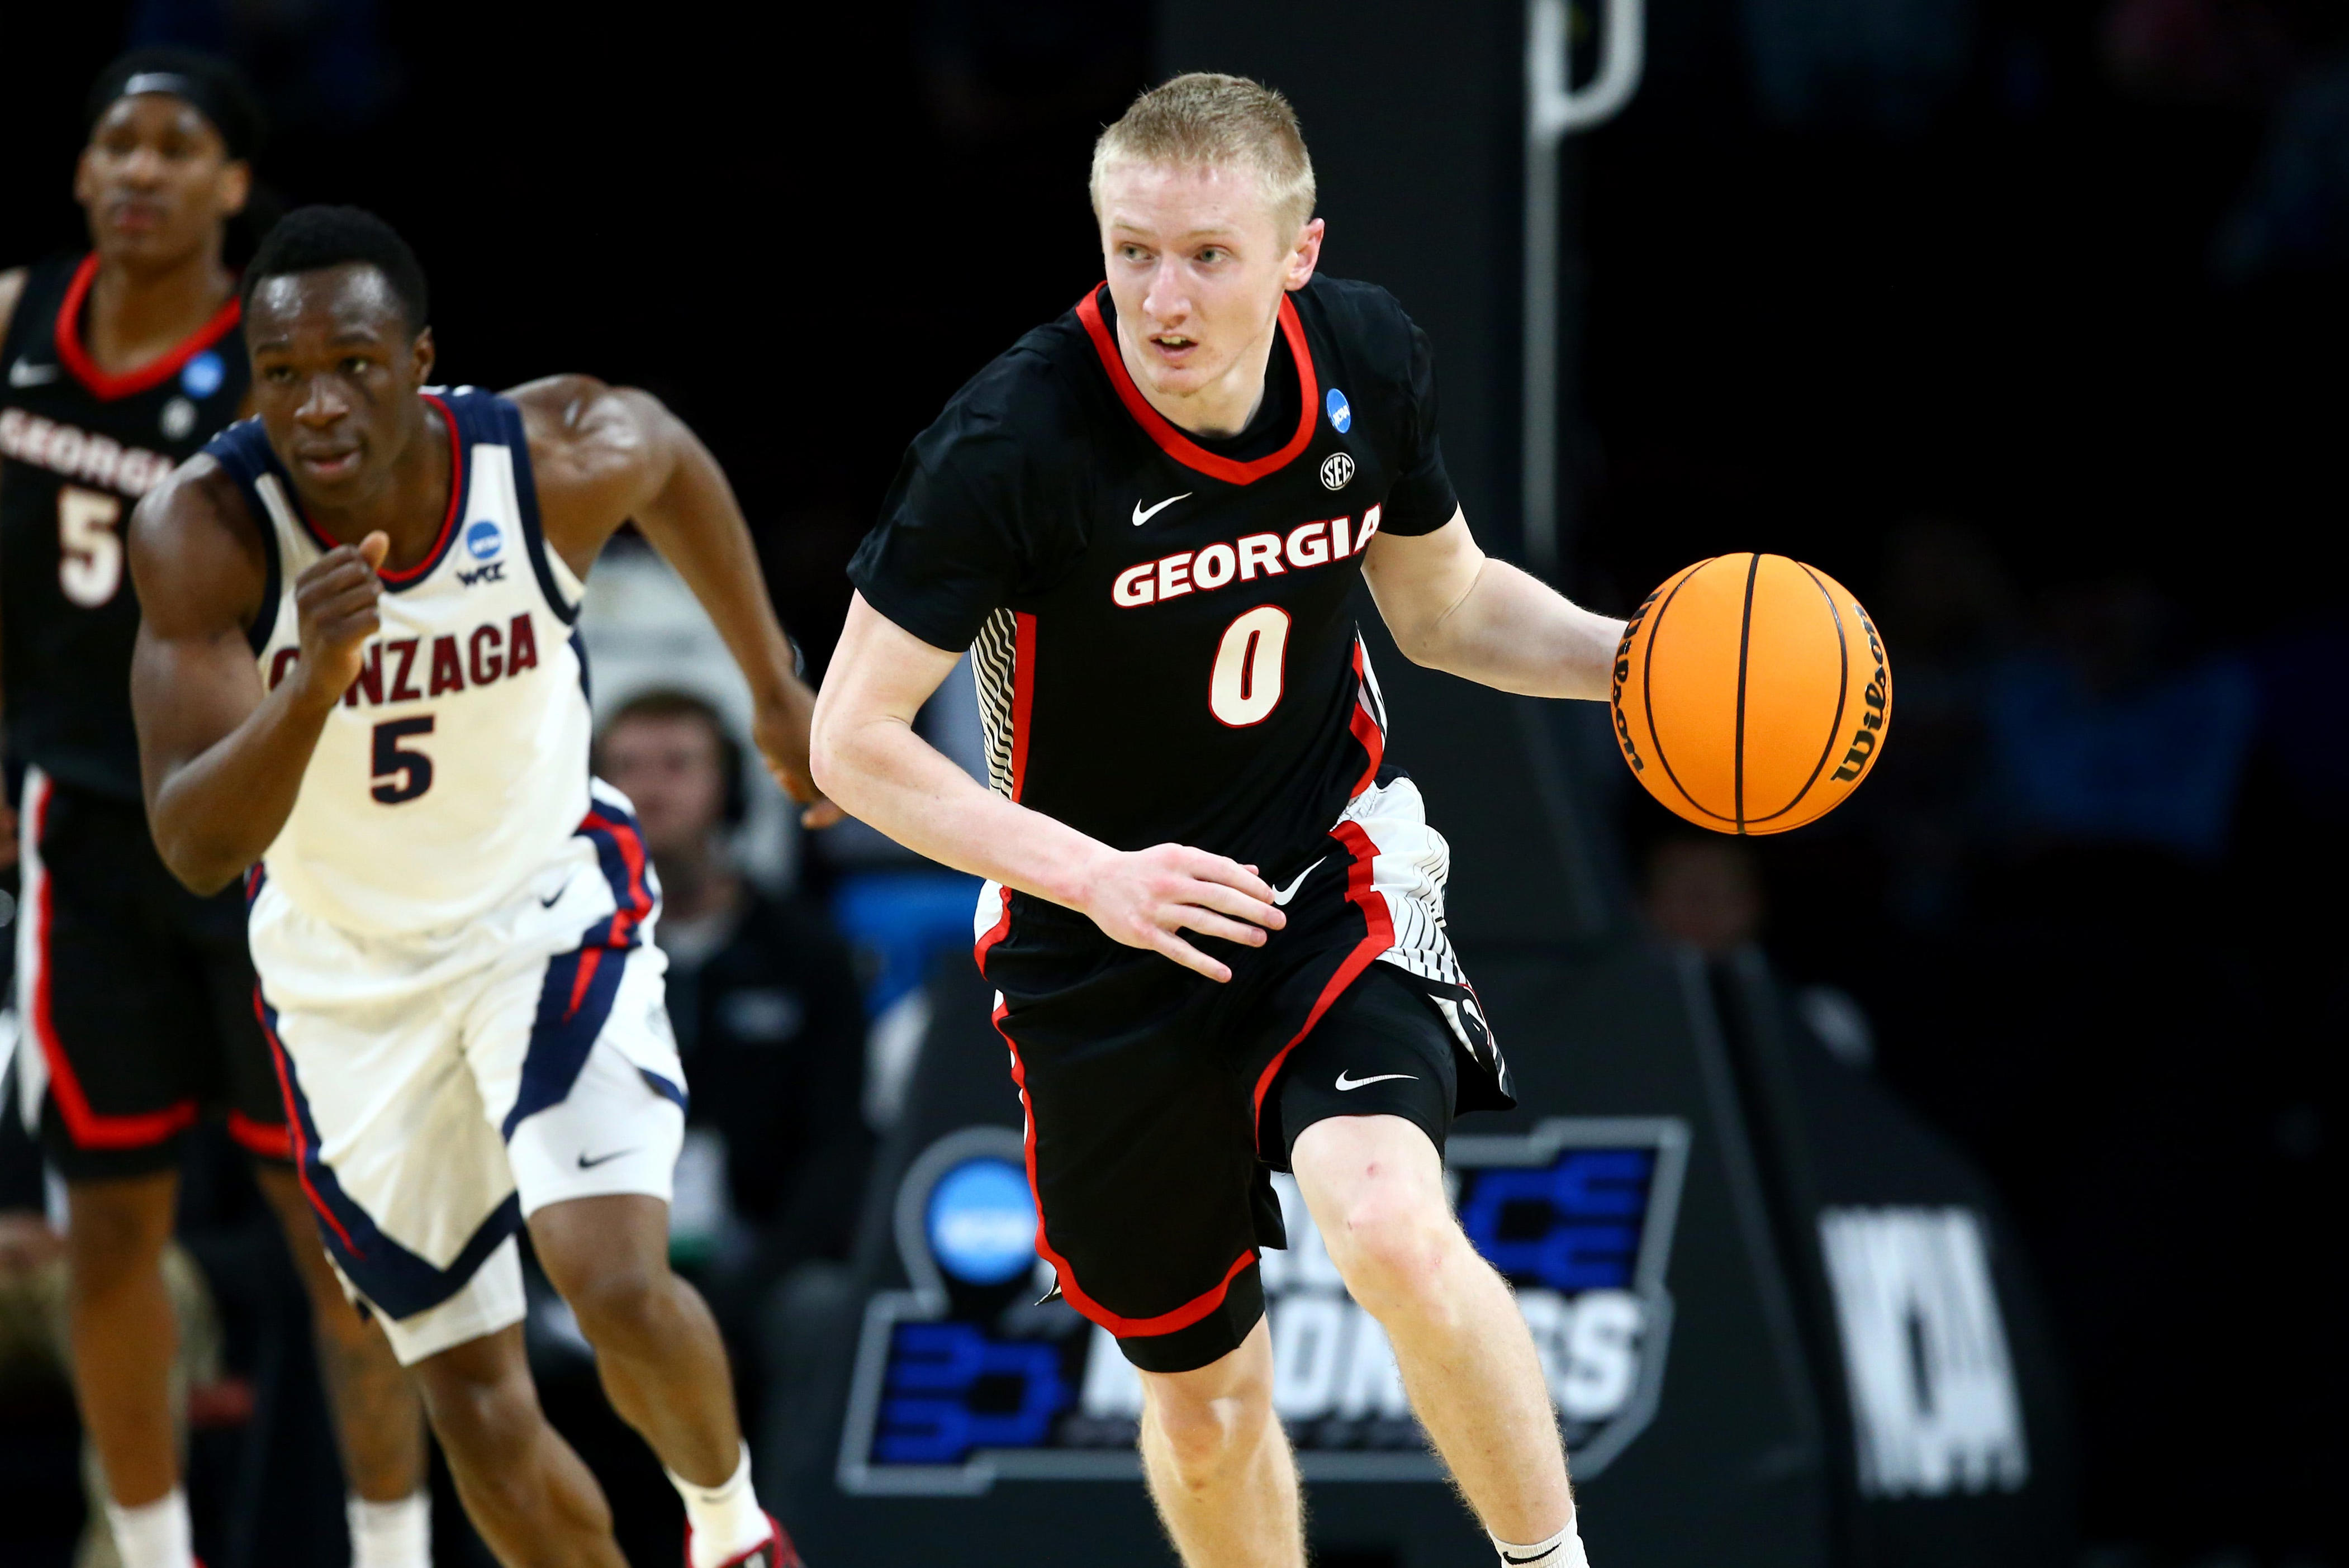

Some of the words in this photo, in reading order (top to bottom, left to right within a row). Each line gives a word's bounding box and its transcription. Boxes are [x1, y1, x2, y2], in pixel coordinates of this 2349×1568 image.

[1324, 456, 1351, 487] SEC
[58, 483, 124, 609] 5
[1112, 502, 1381, 609] GEORGIA
[269, 612, 538, 707] NZAGA
[1208, 604, 1292, 728] 0
[1830, 603, 1886, 782] Wilson
[369, 712, 436, 806] 5
